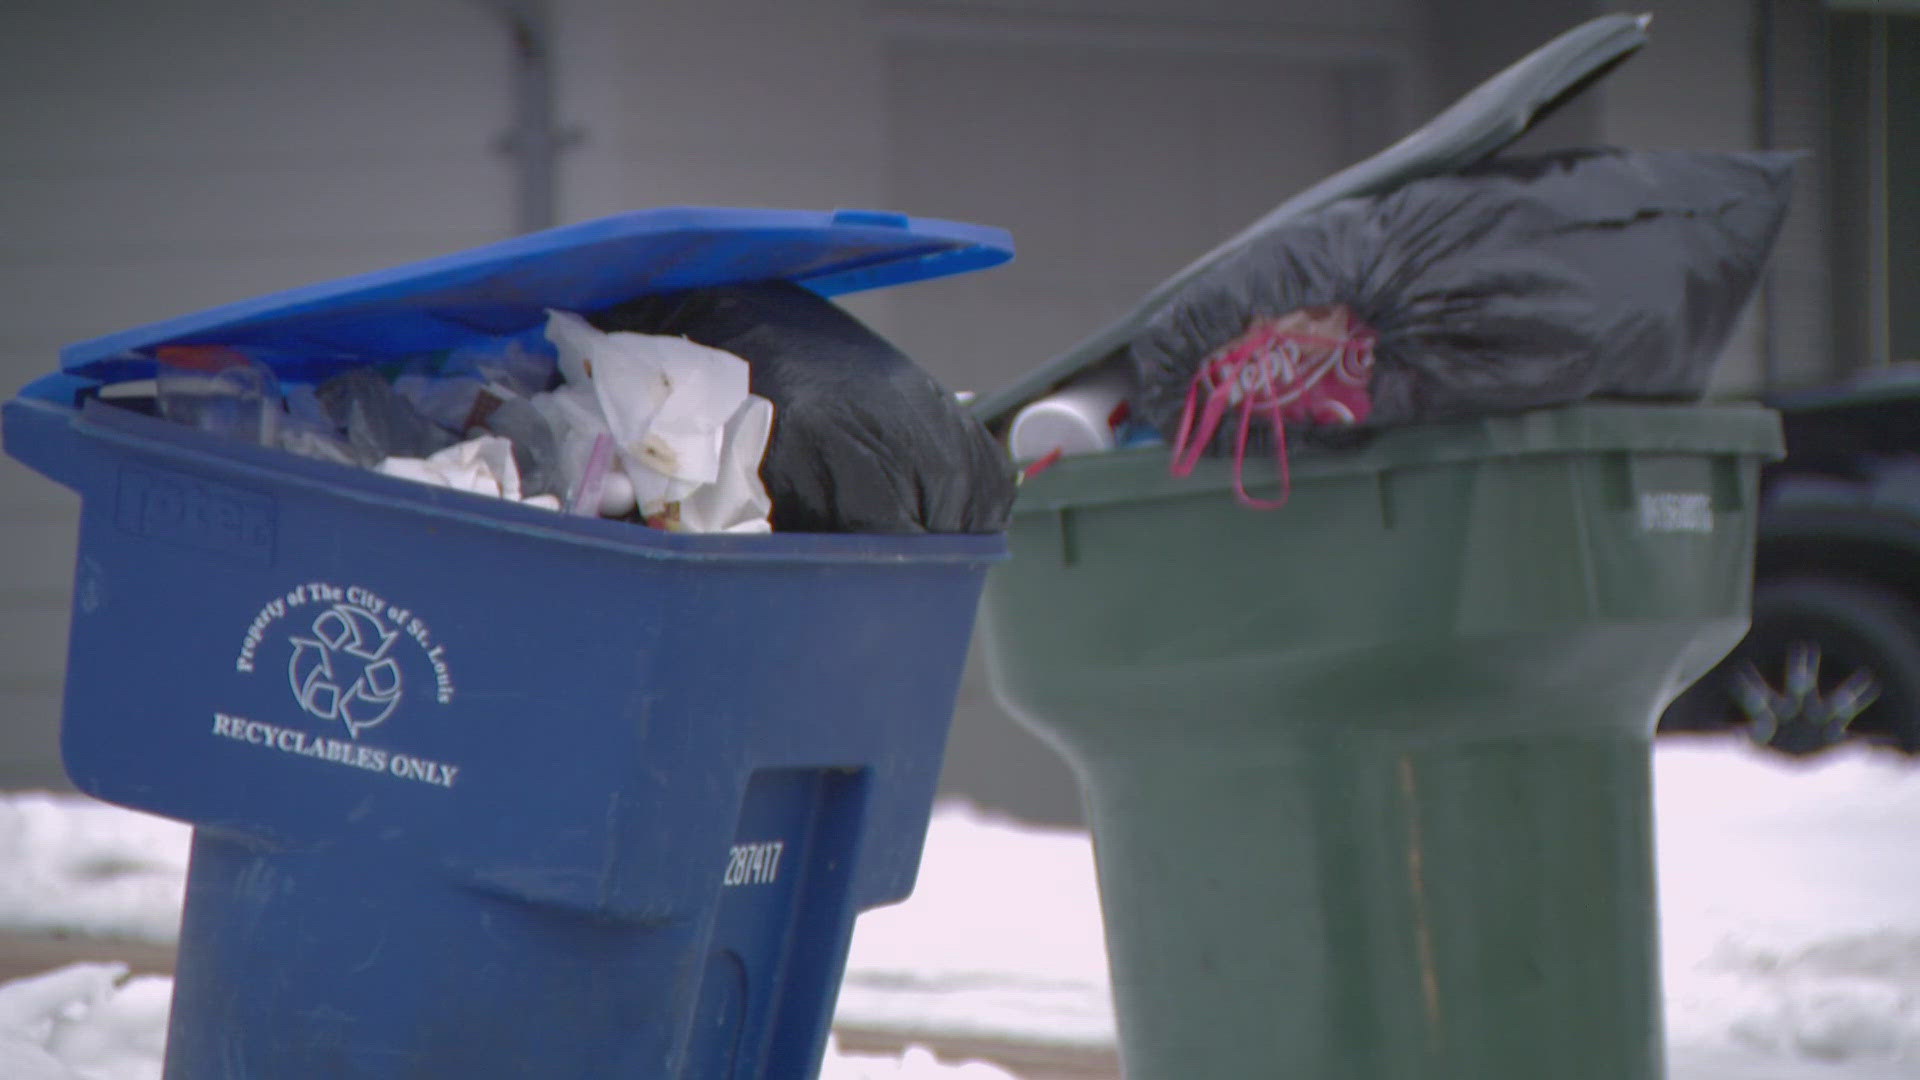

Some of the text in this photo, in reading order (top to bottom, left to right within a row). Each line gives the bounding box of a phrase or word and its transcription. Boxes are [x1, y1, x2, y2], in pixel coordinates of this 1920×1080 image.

[236, 582, 454, 704] Property of The City of St. Louis
[212, 712, 459, 788] RECYCLABLES ONLY
[723, 841, 783, 886] 287417
